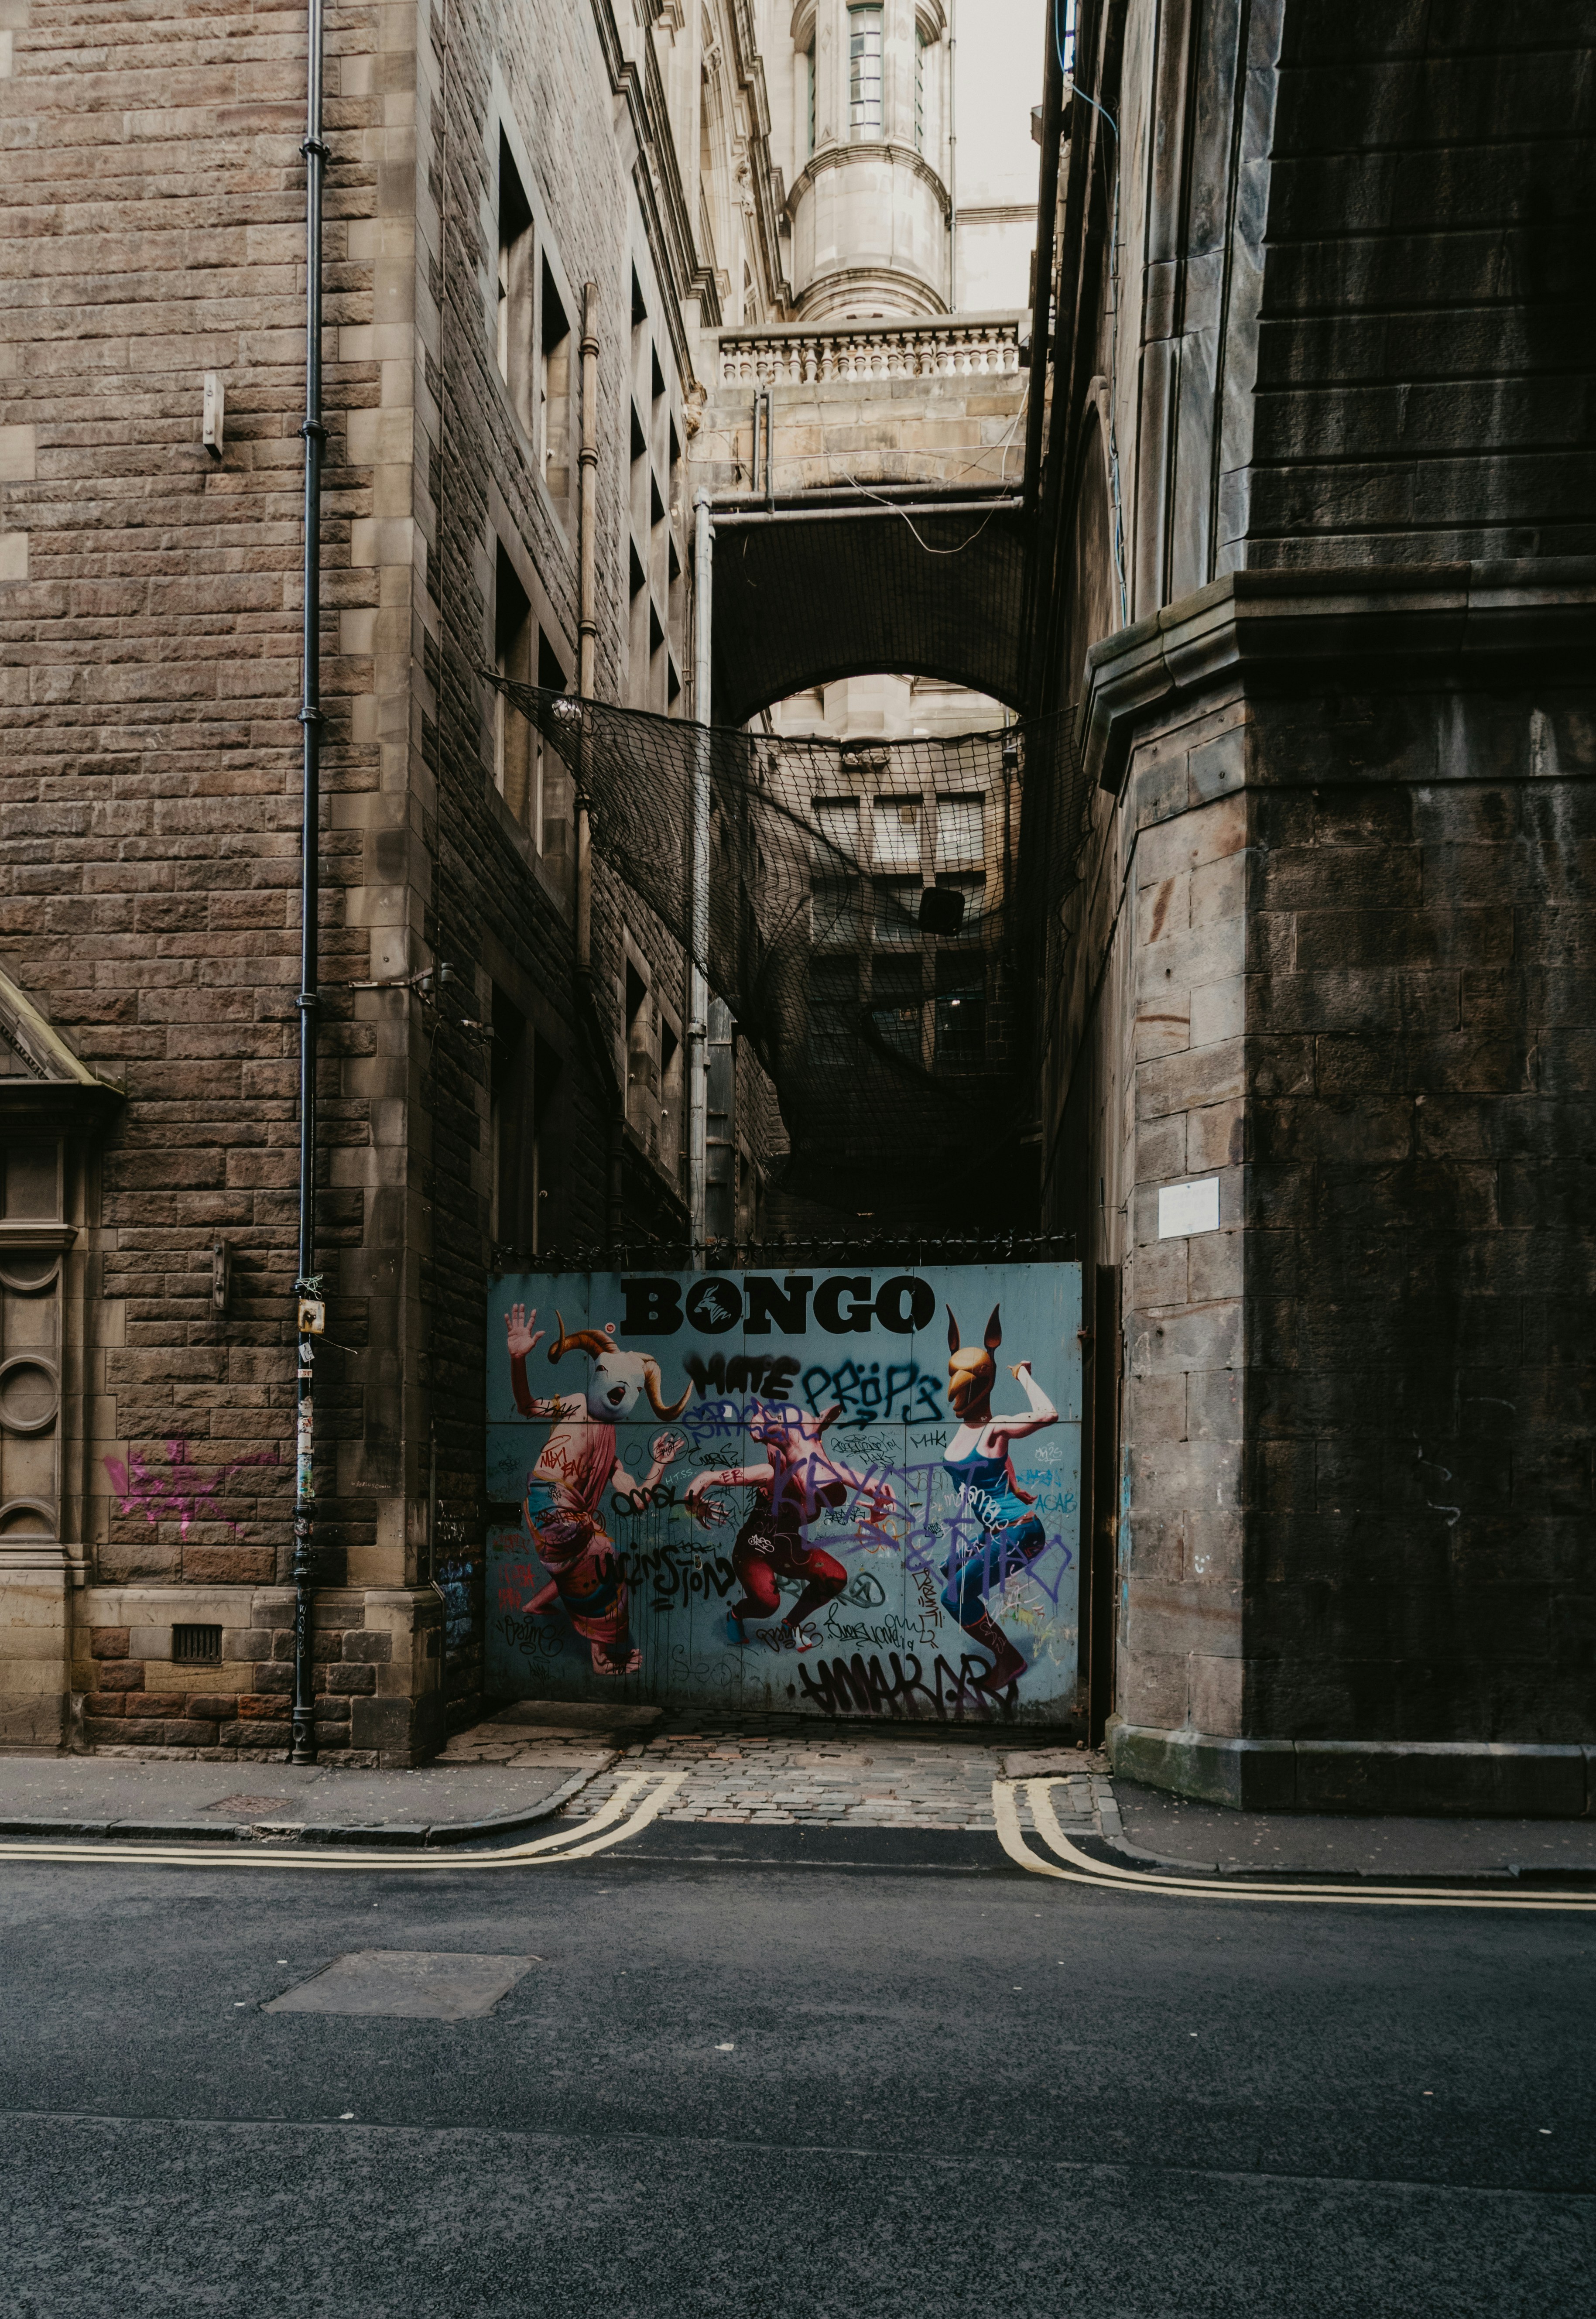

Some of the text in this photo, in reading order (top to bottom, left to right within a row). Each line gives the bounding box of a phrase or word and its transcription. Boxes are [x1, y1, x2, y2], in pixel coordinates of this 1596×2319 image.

[620, 1276, 935, 1336] BONGO
[685, 1353, 801, 1400] MATE
[1035, 1493, 1078, 1513] ACAB
